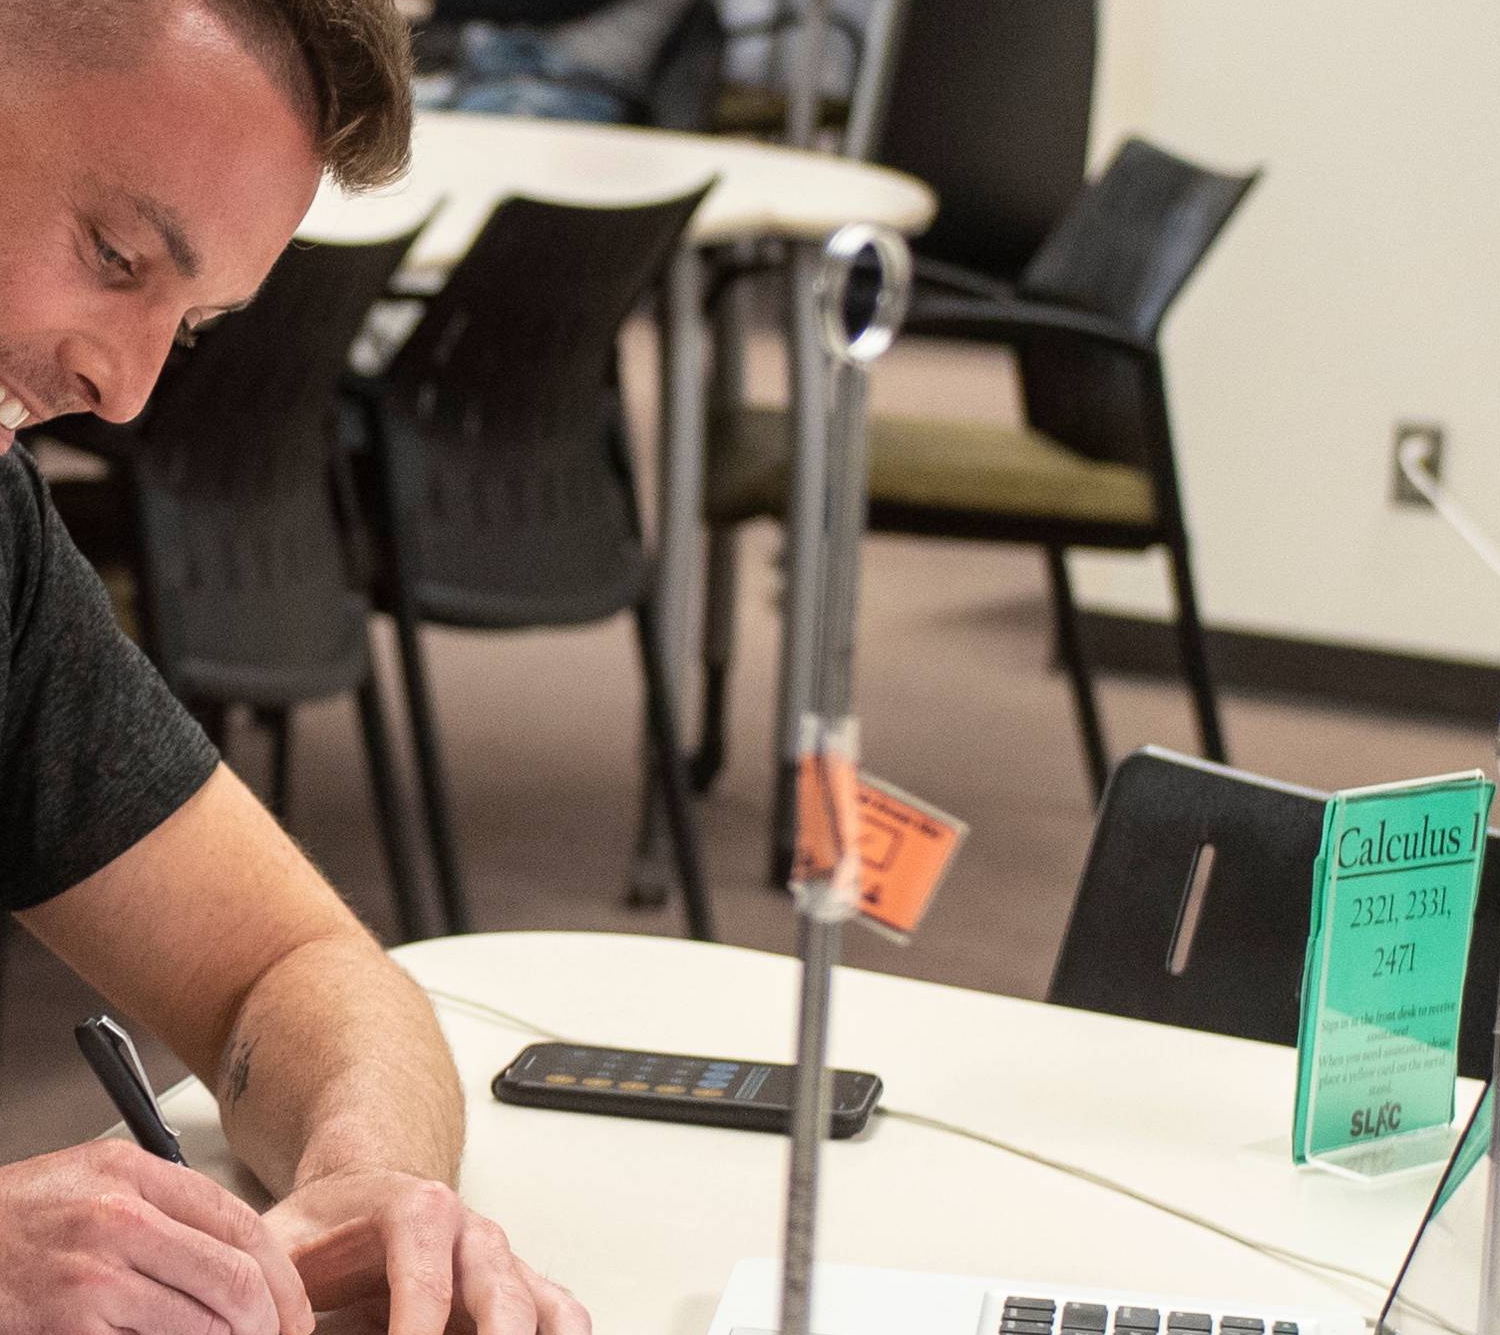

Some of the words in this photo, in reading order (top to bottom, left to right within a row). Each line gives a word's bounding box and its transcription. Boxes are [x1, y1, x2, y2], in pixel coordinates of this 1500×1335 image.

[1338, 815, 1461, 869] Calculus
[1350, 893, 1399, 928] 2321,
[1405, 886, 1452, 920] 2331,
[1372, 942, 1416, 978] 2471
